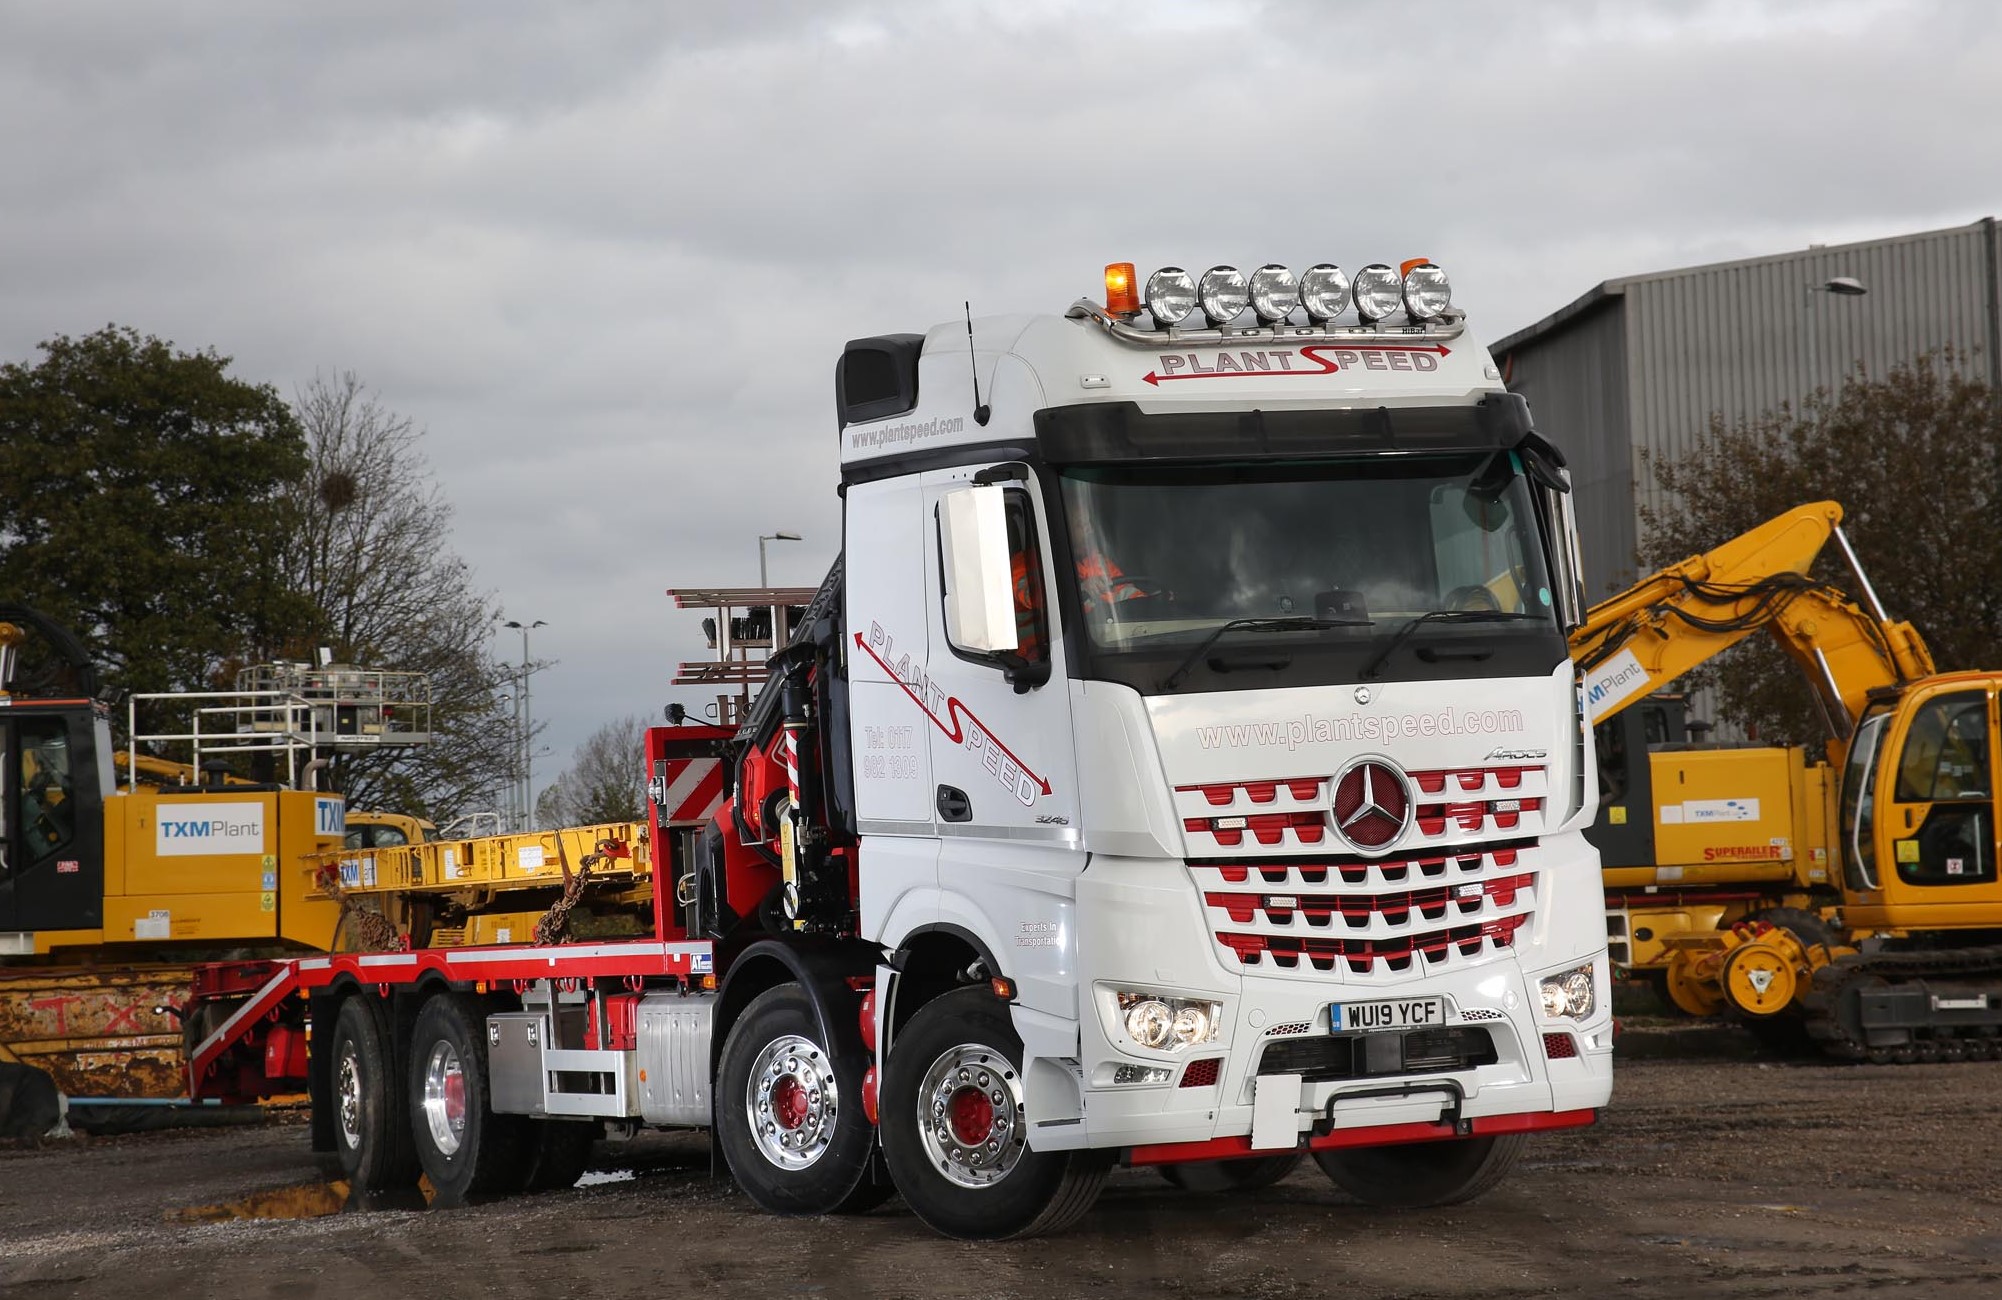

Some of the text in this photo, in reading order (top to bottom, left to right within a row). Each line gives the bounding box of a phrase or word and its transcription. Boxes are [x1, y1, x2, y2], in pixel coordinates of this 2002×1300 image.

[1402, 327, 1425, 335] HiBar
[851, 417, 964, 449] www.plantspeed.com
[1196, 707, 1524, 751] www.plantspeed.com
[161, 820, 260, 838] TXMPlant
[1703, 845, 1782, 861] SUPERAILER
[1020, 921, 1047, 935] Experts
[1014, 936, 1062, 948] Transportatio
[1348, 1001, 1437, 1028] WU19 YCF
